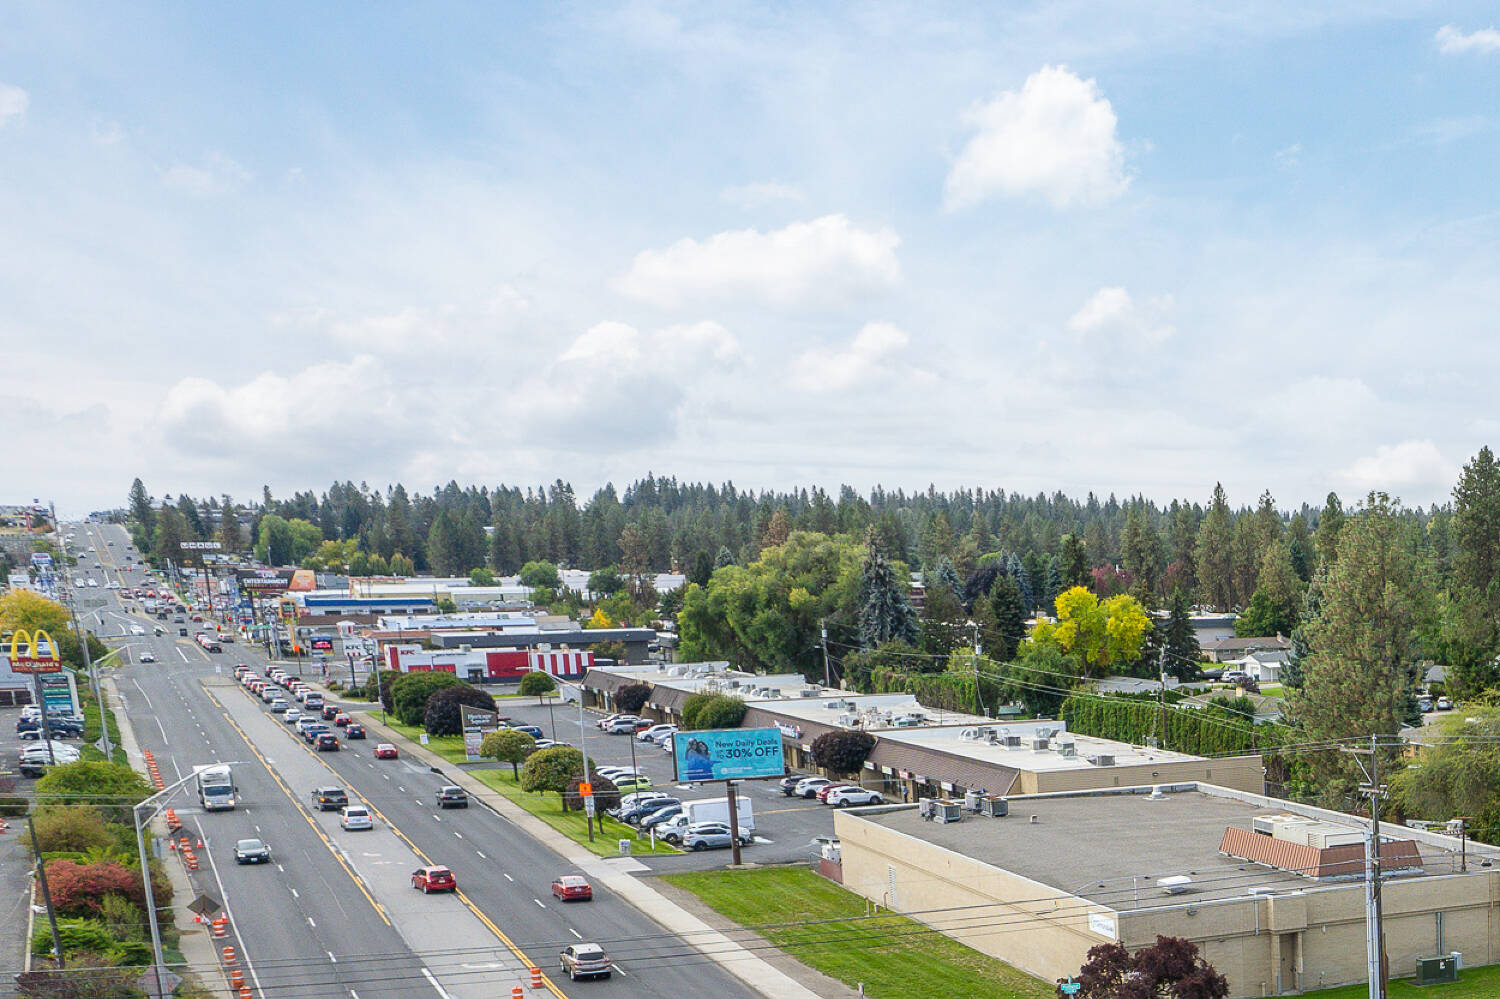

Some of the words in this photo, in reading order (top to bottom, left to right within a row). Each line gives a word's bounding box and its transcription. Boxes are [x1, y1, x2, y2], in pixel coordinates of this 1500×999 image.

[735, 740, 755, 748] Daily
[756, 738, 778, 746] Deals
[725, 748, 752, 759] 30%
[755, 746, 779, 757] OFF
